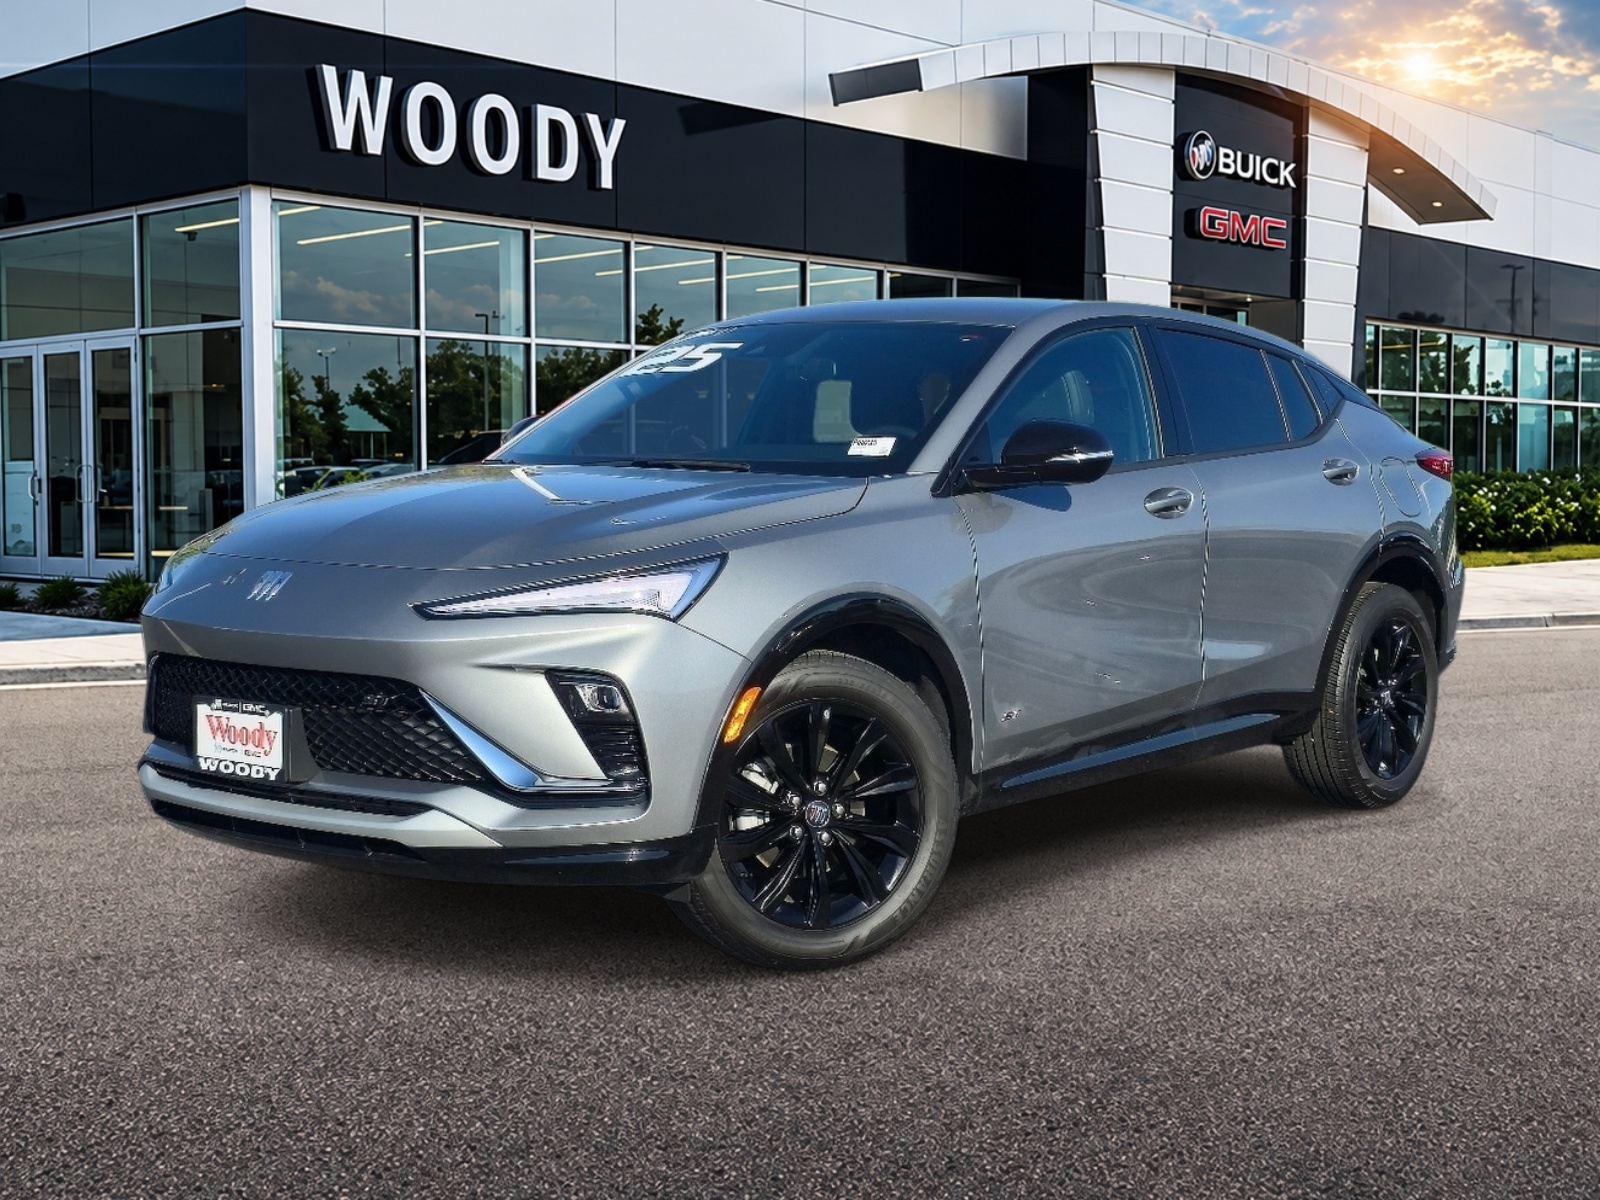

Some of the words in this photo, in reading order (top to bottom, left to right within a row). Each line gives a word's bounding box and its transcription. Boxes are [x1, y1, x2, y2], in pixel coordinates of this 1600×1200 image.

[315, 63, 627, 189] WOODY
[1218, 146, 1297, 188] BUICK
[1200, 205, 1287, 249] GMC
[617, 342, 744, 378] 25
[205, 714, 278, 756] Woody
[199, 757, 280, 780] WOODY
